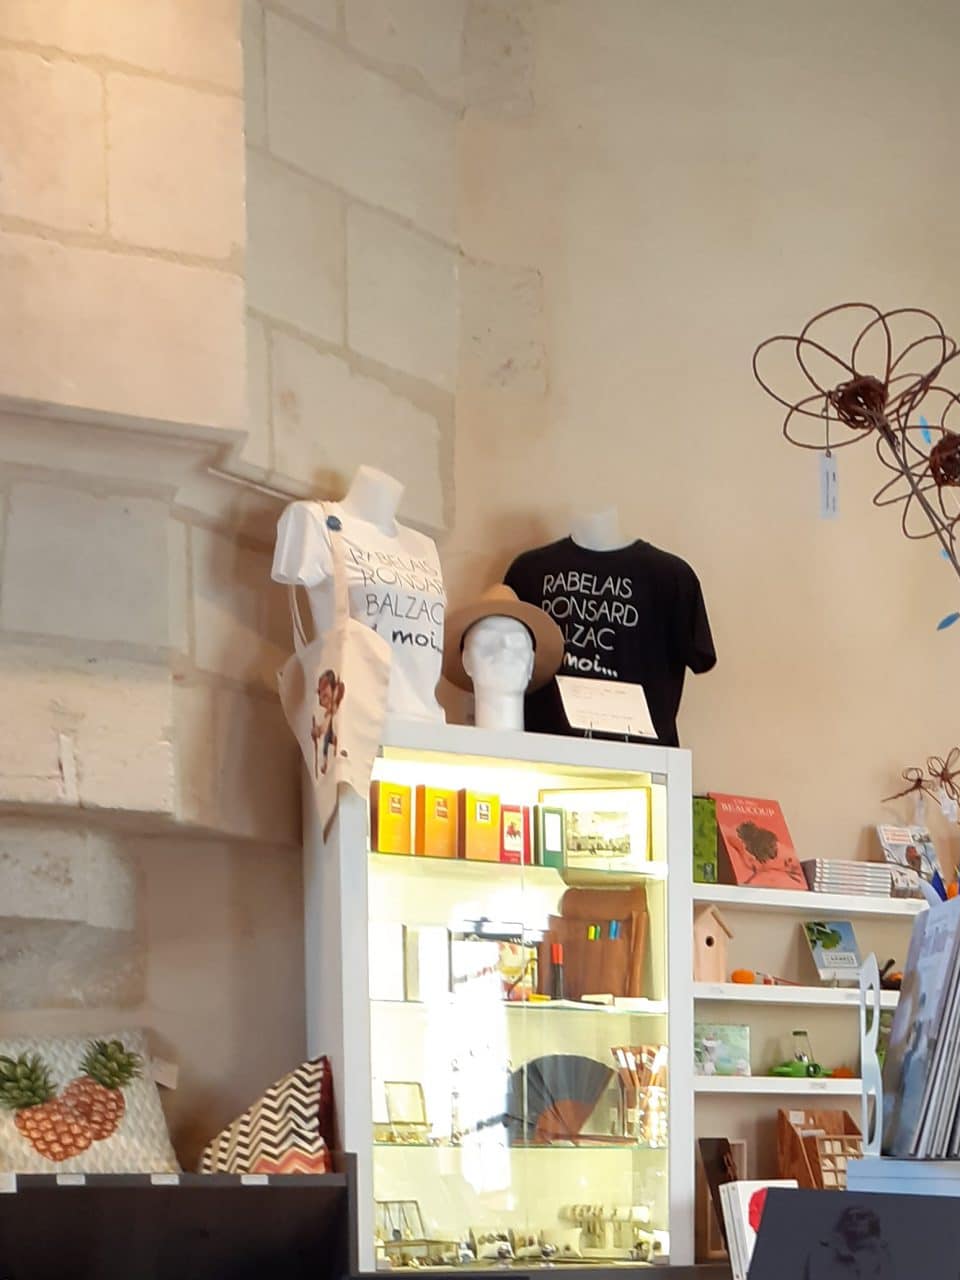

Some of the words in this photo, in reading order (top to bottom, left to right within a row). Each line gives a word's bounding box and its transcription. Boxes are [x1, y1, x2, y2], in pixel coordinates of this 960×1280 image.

[542, 570, 633, 599] RABELAIS
[365, 591, 445, 626] BALZAC
[541, 595, 640, 628] RONSARD
[564, 622, 616, 651] LZAC
[563, 651, 618, 678] moi...
